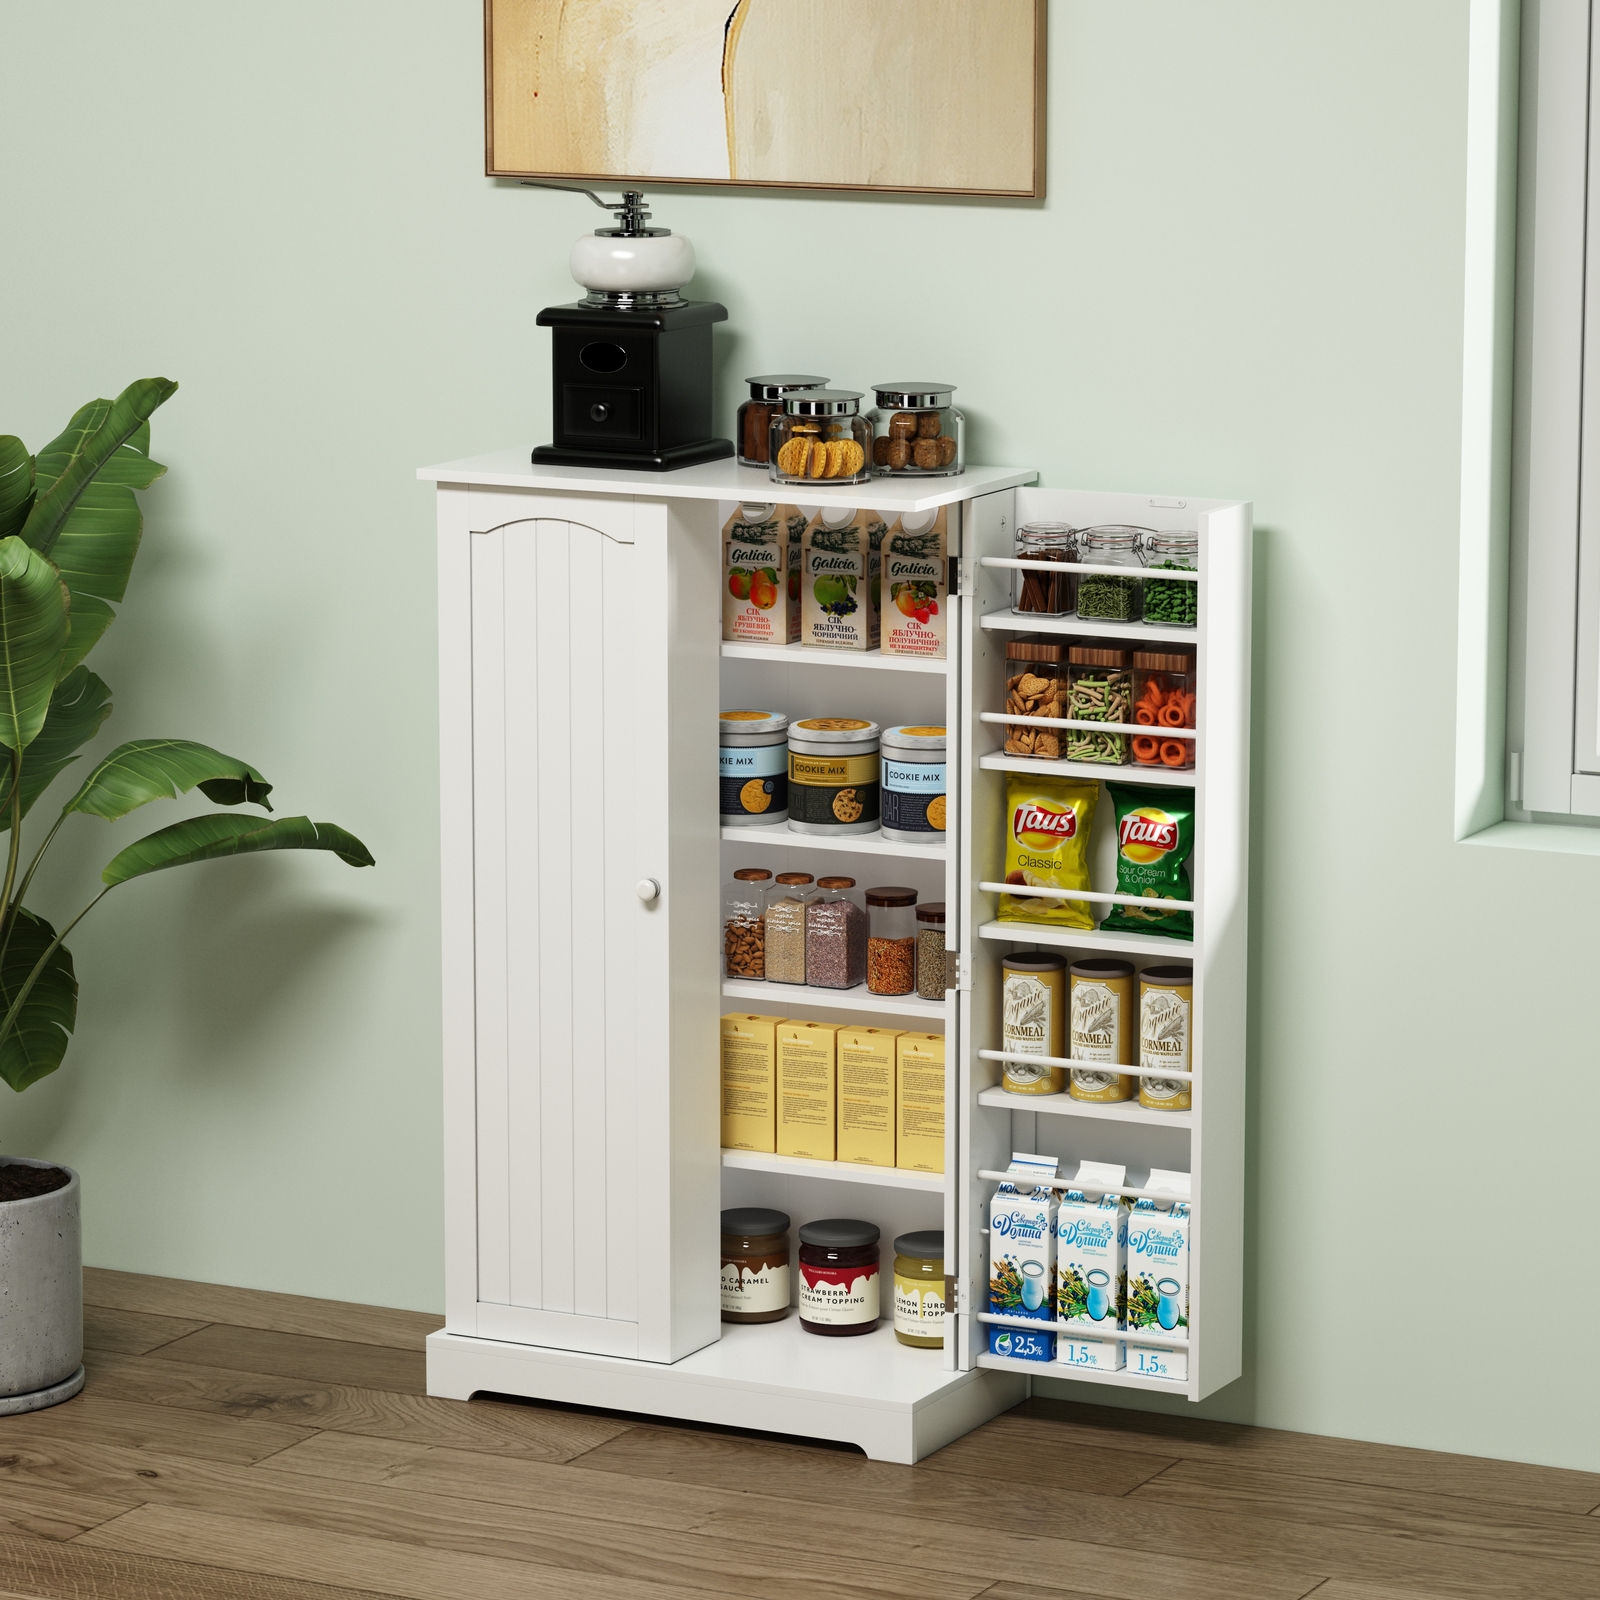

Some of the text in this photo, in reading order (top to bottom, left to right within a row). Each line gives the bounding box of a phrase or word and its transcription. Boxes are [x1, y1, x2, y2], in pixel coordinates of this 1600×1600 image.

[732, 548, 776, 564] Galicia
[812, 556, 858, 571] Galicia
[891, 562, 938, 576] Galicia
[746, 608, 760, 616] СІК
[734, 622, 770, 630] ГРУШЕВИЙ
[828, 616, 842, 624] СІК
[906, 622, 922, 630] СІК
[812, 631, 858, 640] ЧОРНИЧНИЙ
[813, 624, 857, 634] ЯБЛУЧНО-
[892, 629, 936, 639] ЯБЛУЧНО-
[888, 637, 940, 646] ПОЛУНИЧНИЙ
[795, 764, 825, 774] COOKIE
[889, 771, 920, 781] COOKIE
[1018, 854, 1062, 870] Classic
[1120, 865, 1166, 877] Sour Cream
[1131, 874, 1155, 884] Onion
[1005, 989, 1043, 1023] Organic
[1072, 996, 1111, 1030] Organic
[1142, 1003, 1181, 1038] Organic
[1005, 1023, 1045, 1036] CORNMEAL
[1073, 1030, 1113, 1044] CORNMEAL
[1142, 1038, 1183, 1051] CORNMEAL
[1011, 1211, 1040, 1226] Северная
[993, 1214, 1041, 1239] Долина
[1077, 1219, 1104, 1235] Северная
[1059, 1222, 1107, 1248] Долина
[1147, 1228, 1175, 1243] Северная
[1129, 1230, 1178, 1257] Долина
[801, 1284, 849, 1296] STRAWBERRY
[802, 1293, 822, 1303] CREAM
[896, 1297, 917, 1307] LEMON
[897, 1305, 918, 1316] CREAM
[1015, 1336, 1043, 1356] 2,5%
[1068, 1345, 1097, 1364] 1,5%
[1138, 1354, 1167, 1374] 1,5%
